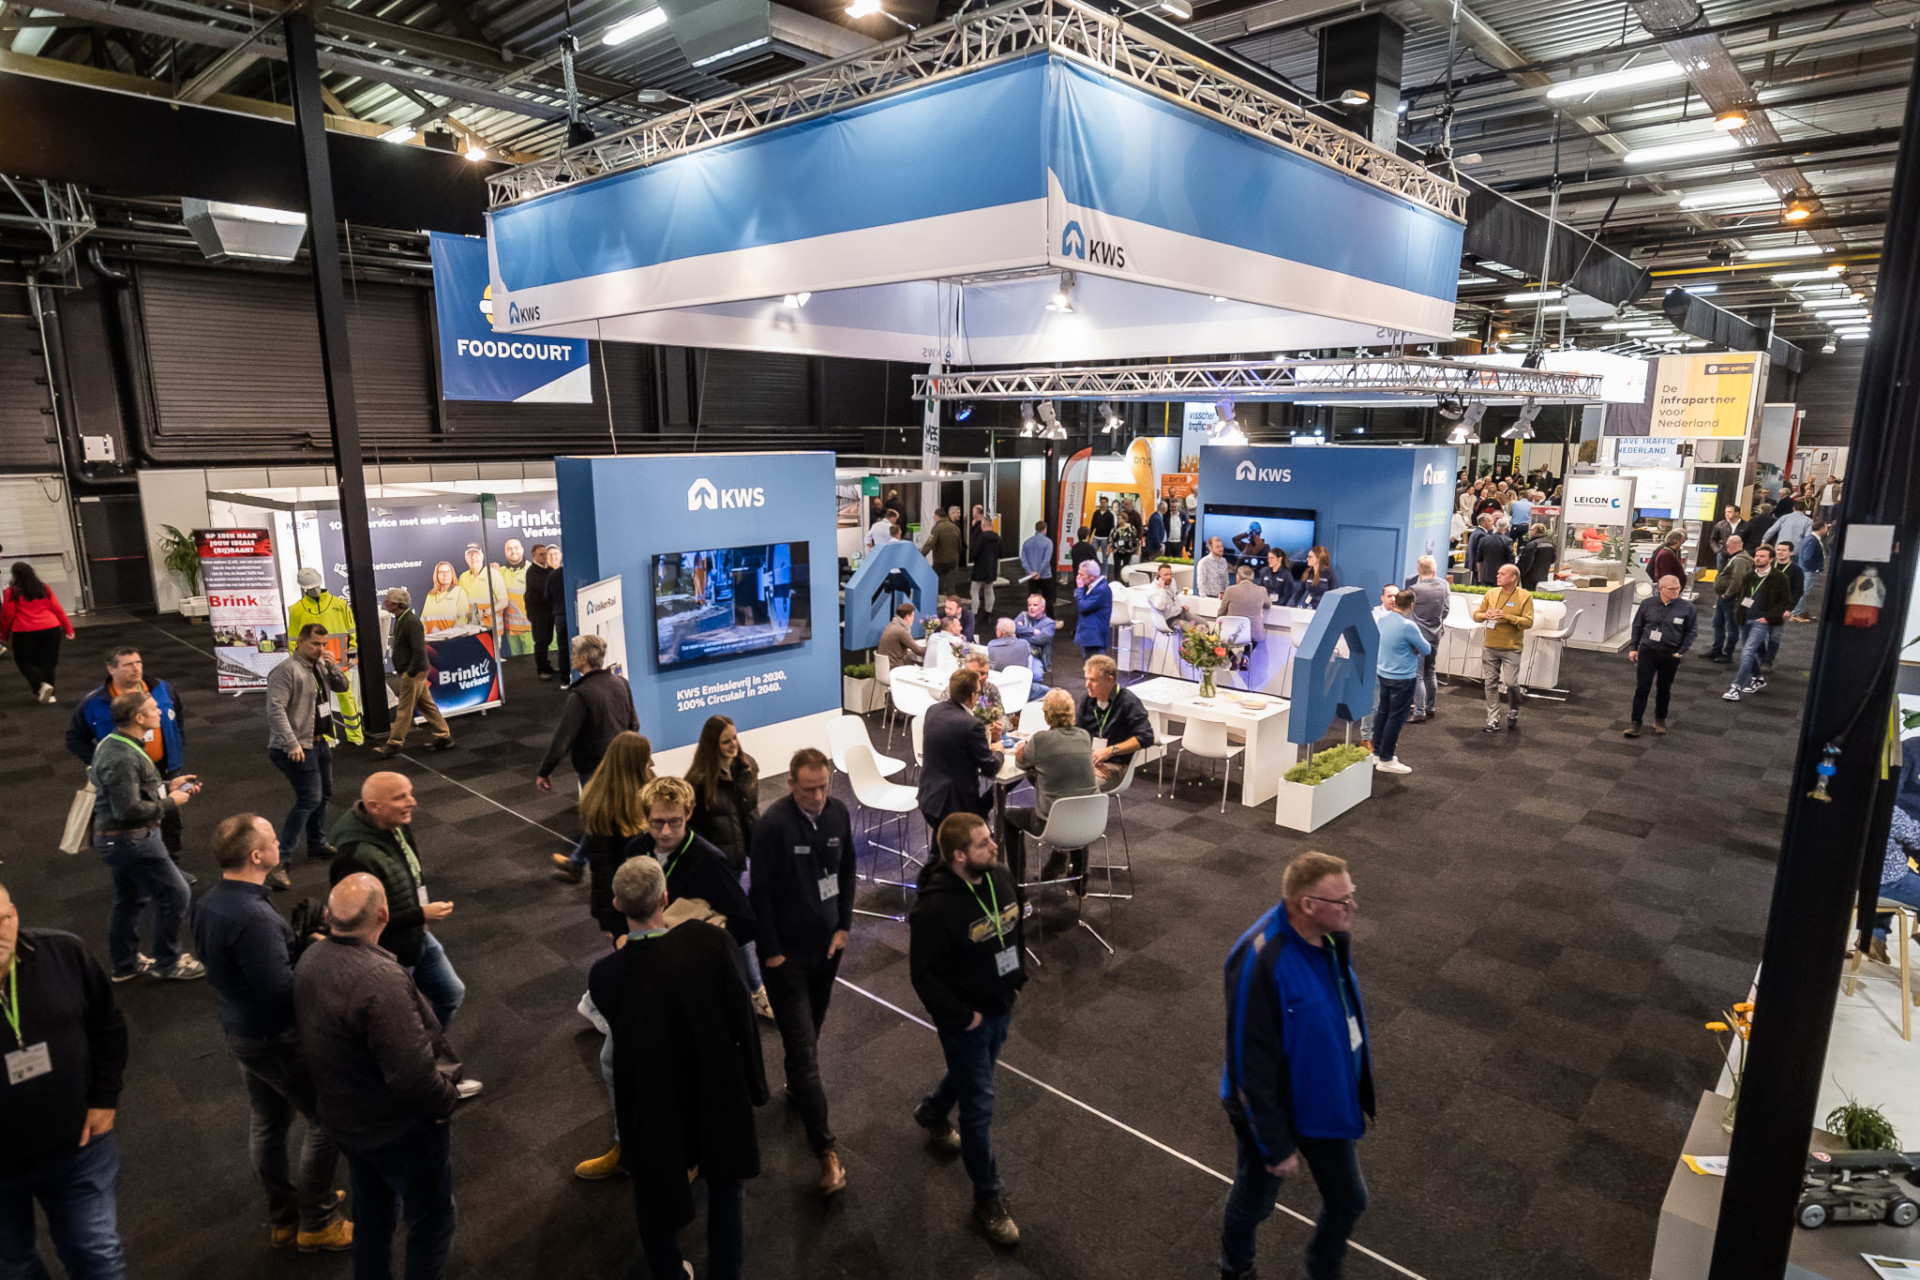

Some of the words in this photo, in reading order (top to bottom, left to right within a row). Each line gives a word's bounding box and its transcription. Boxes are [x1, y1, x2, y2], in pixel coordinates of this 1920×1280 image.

[1089, 239, 1125, 268] KWS
[519, 306, 541, 323] KWS
[457, 339, 572, 361] FOODCOURT
[1662, 384, 1678, 393] De
[1660, 395, 1736, 407] infrapartner
[1189, 411, 1215, 420] visscher
[1188, 421, 1206, 433] traffic
[1657, 419, 1720, 428] Nederland
[1618, 446, 1667, 454] NEDERLAND
[1258, 468, 1292, 483] KWS
[721, 487, 766, 509] KWS
[1574, 496, 1609, 504] LEICON
[399, 517, 419, 526] met
[420, 517, 438, 525] een
[496, 509, 554, 528] Brink
[372, 560, 422, 571] etrouwbaar
[208, 595, 258, 608] Brink
[438, 664, 480, 685] Brink
[459, 675, 491, 690] Verkeer
[676, 687, 701, 700] KWS
[702, 676, 752, 695] Emissievrij
[752, 676, 761, 685] in
[677, 698, 706, 712] 100%
[707, 690, 746, 706] Circulair
[747, 688, 756, 697] in
